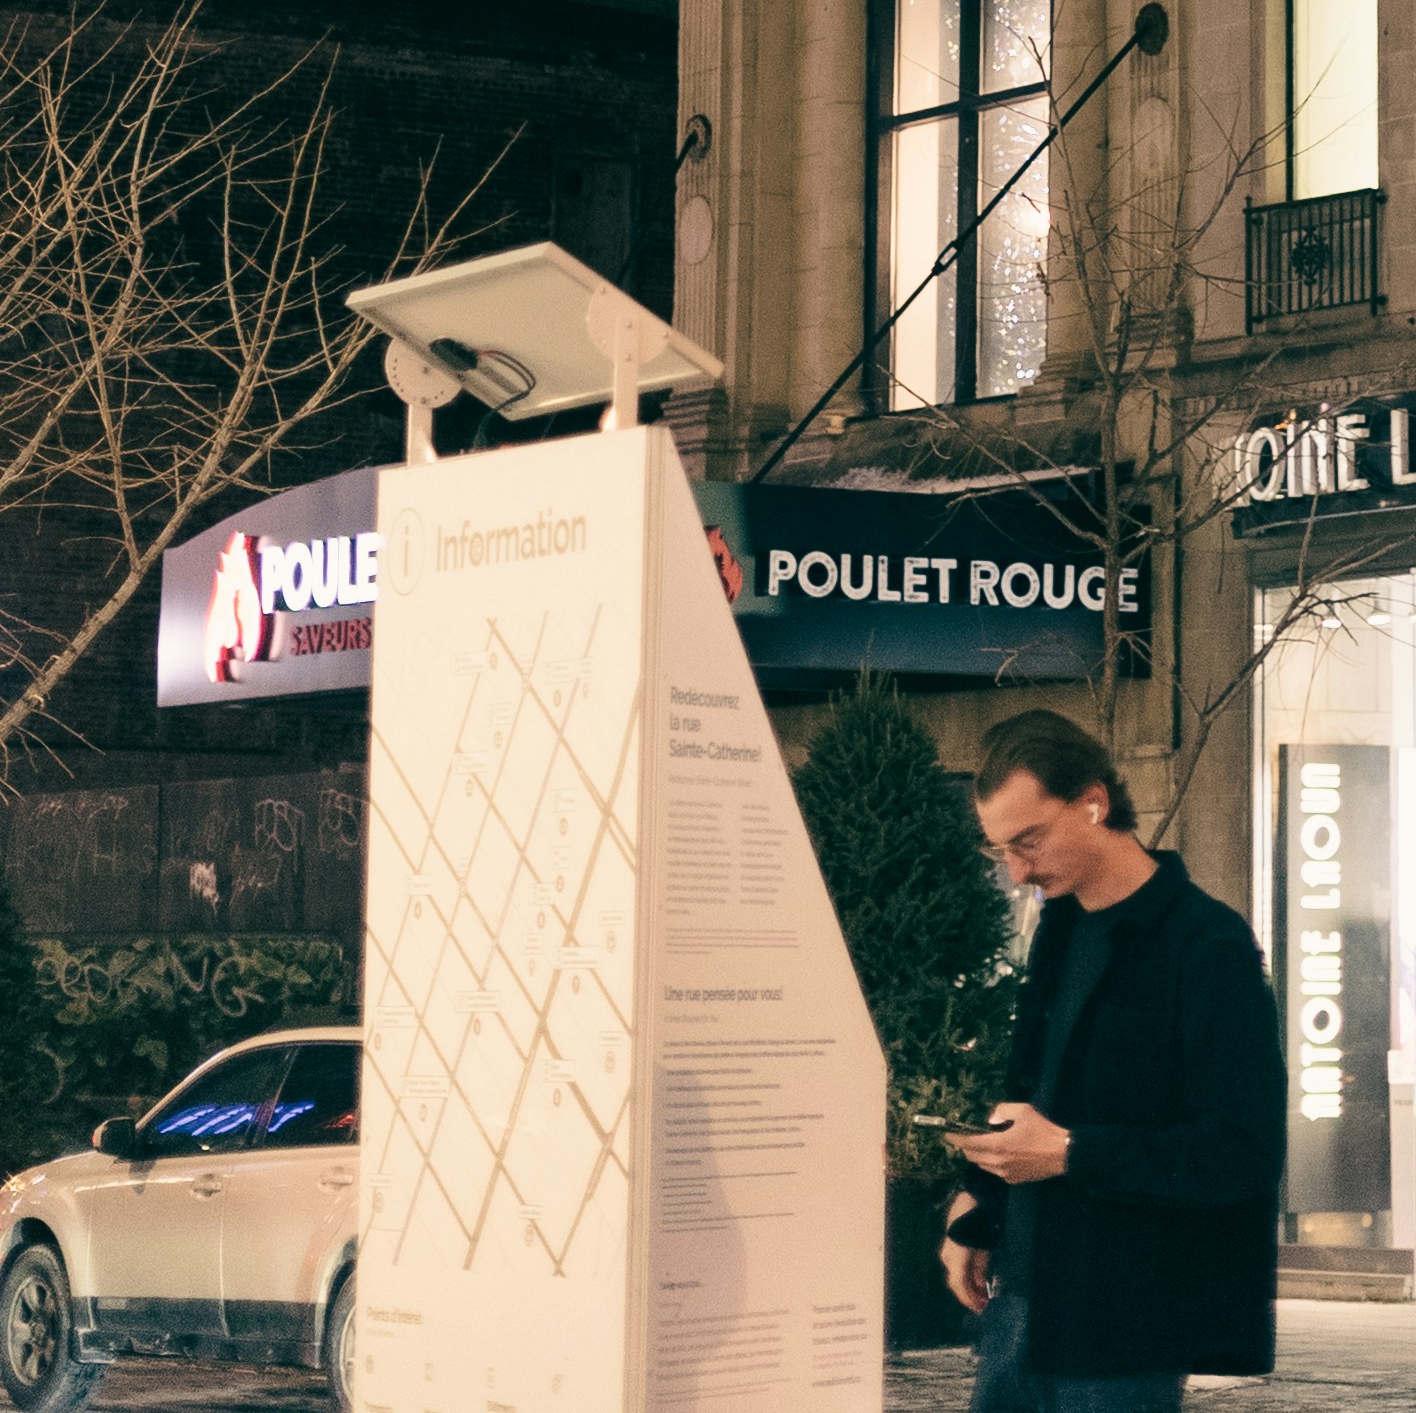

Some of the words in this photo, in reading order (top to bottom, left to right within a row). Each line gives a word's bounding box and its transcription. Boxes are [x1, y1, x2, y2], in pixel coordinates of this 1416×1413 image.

[435, 506, 588, 572] Information
[767, 549, 957, 604] POULET
[970, 559, 1139, 613] ROUGE
[1300, 761, 1343, 910] LAOUN
[1301, 930, 1343, 1123] ANTOINE
